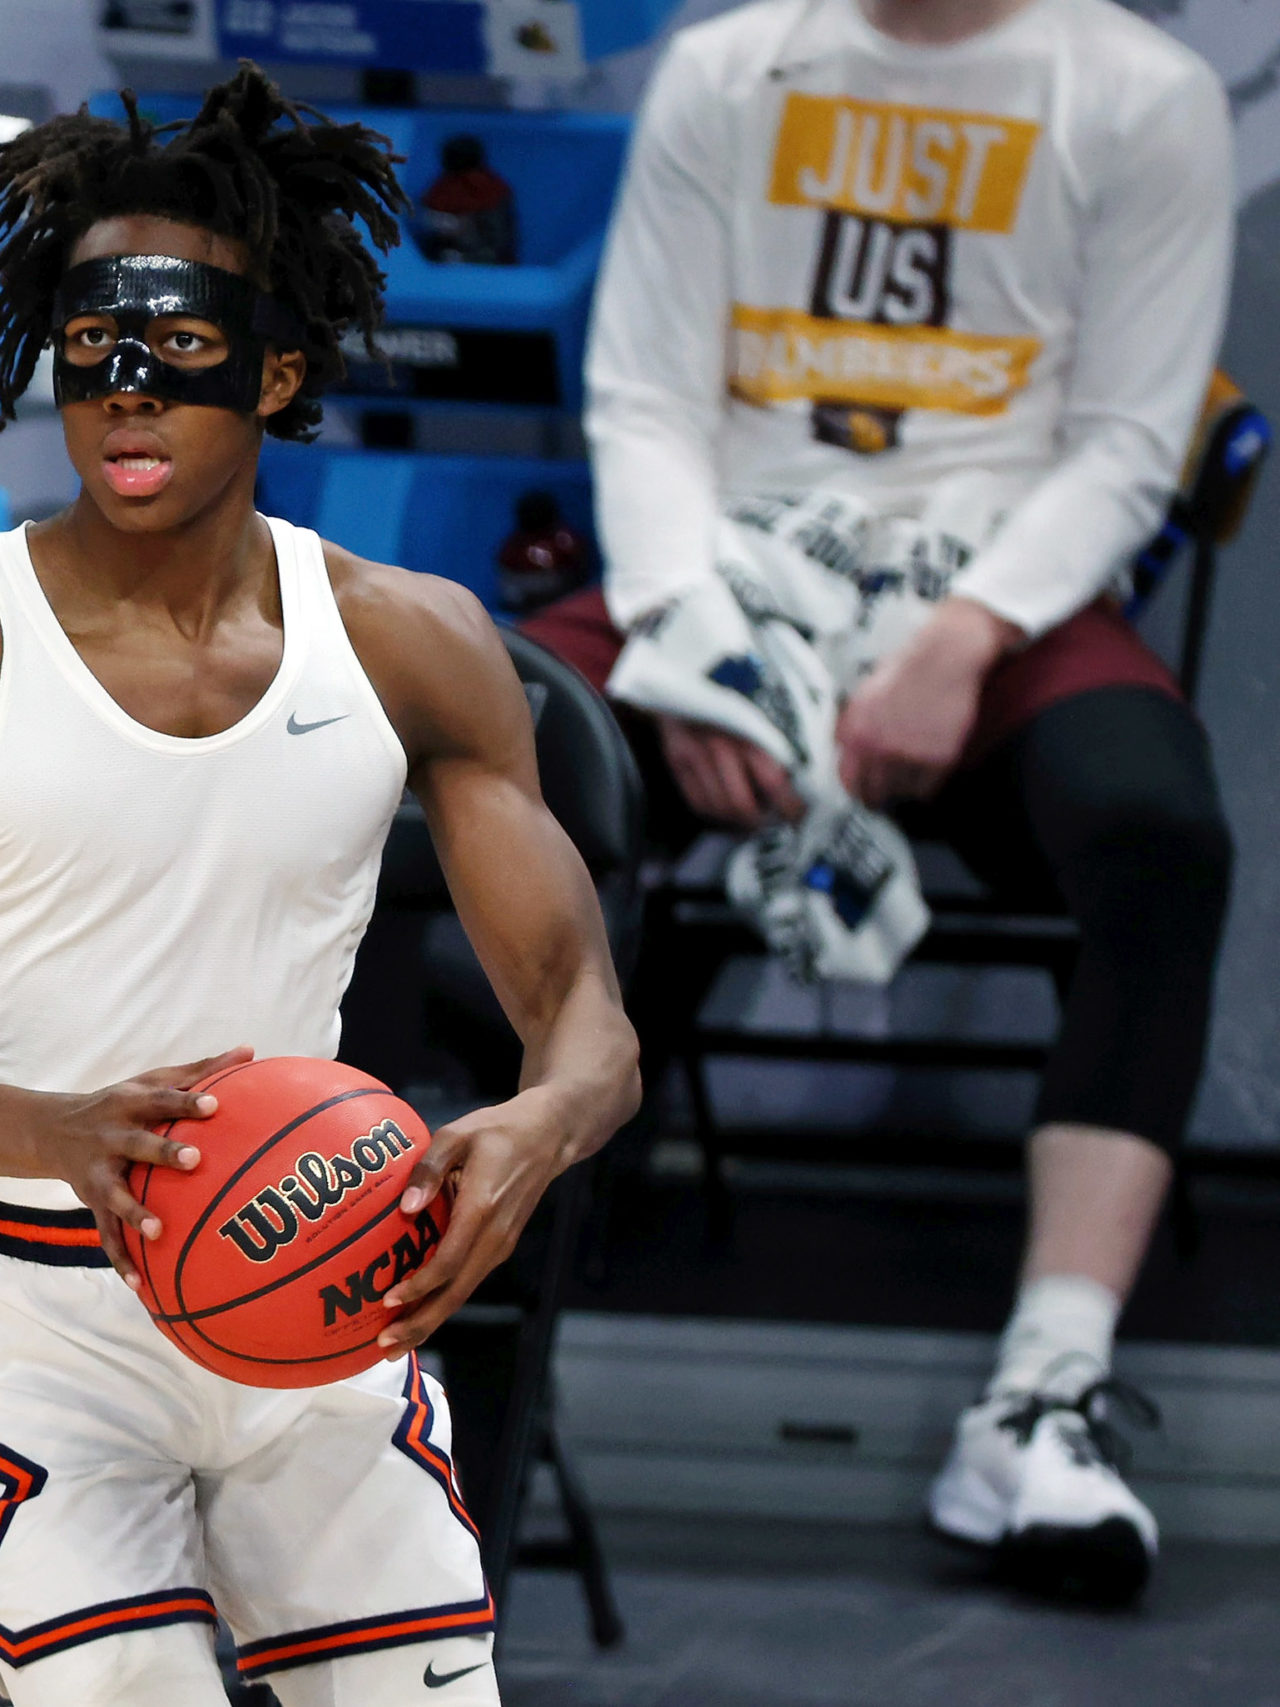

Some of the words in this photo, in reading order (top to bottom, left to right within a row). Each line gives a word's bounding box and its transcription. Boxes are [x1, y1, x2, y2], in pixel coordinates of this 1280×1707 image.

[799, 106, 1008, 221] JUST
[829, 214, 939, 324] US
[218, 1118, 415, 1264] Wilson
[318, 1208, 442, 1328] NCAA
